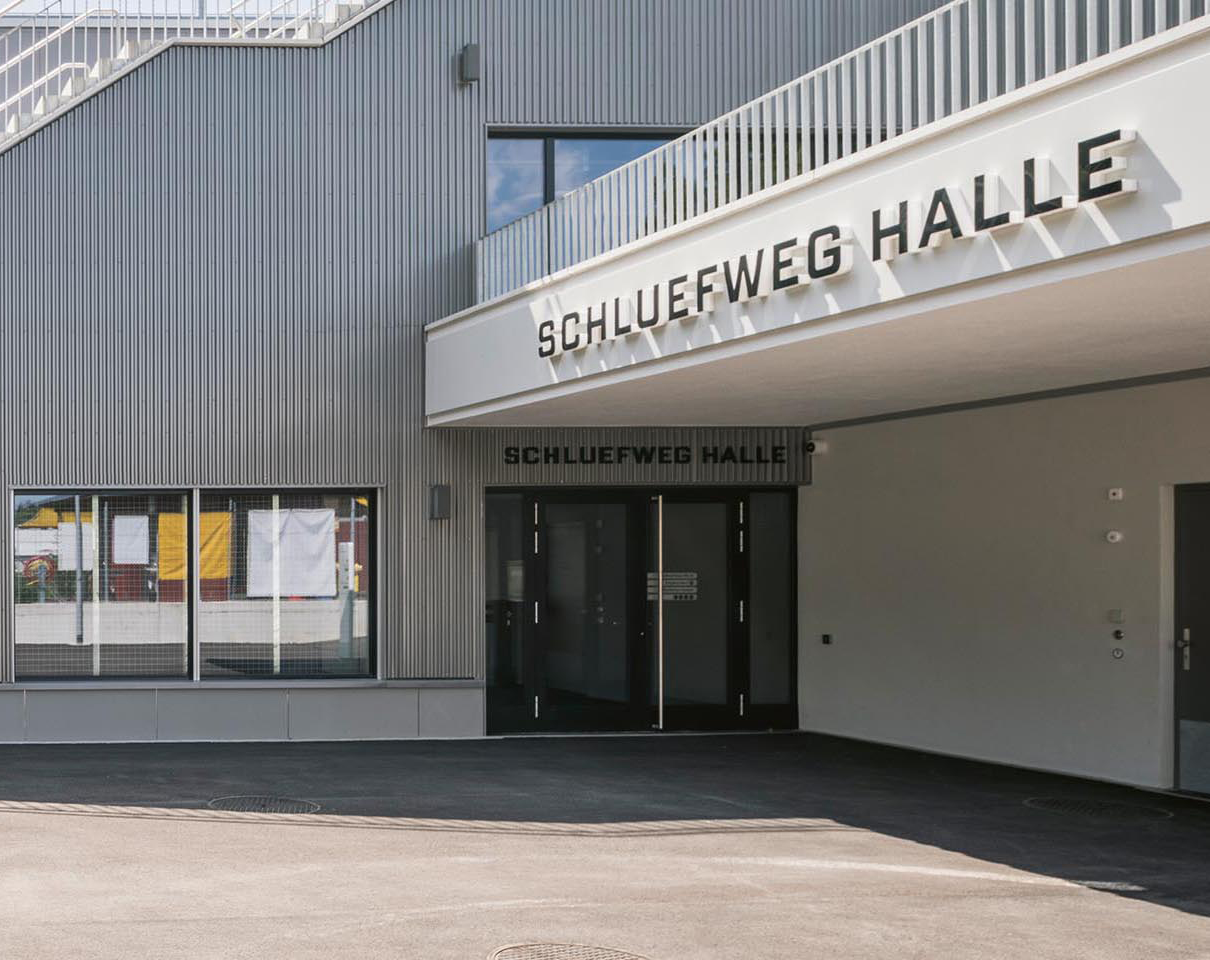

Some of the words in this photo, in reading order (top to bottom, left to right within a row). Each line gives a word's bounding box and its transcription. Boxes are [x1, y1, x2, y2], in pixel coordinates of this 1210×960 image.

[538, 224, 842, 359] SCHLUEFWEG
[871, 128, 1123, 262] HALLE
[503, 445, 692, 465] SCHLUEFWEG
[701, 445, 787, 465] HALLE
